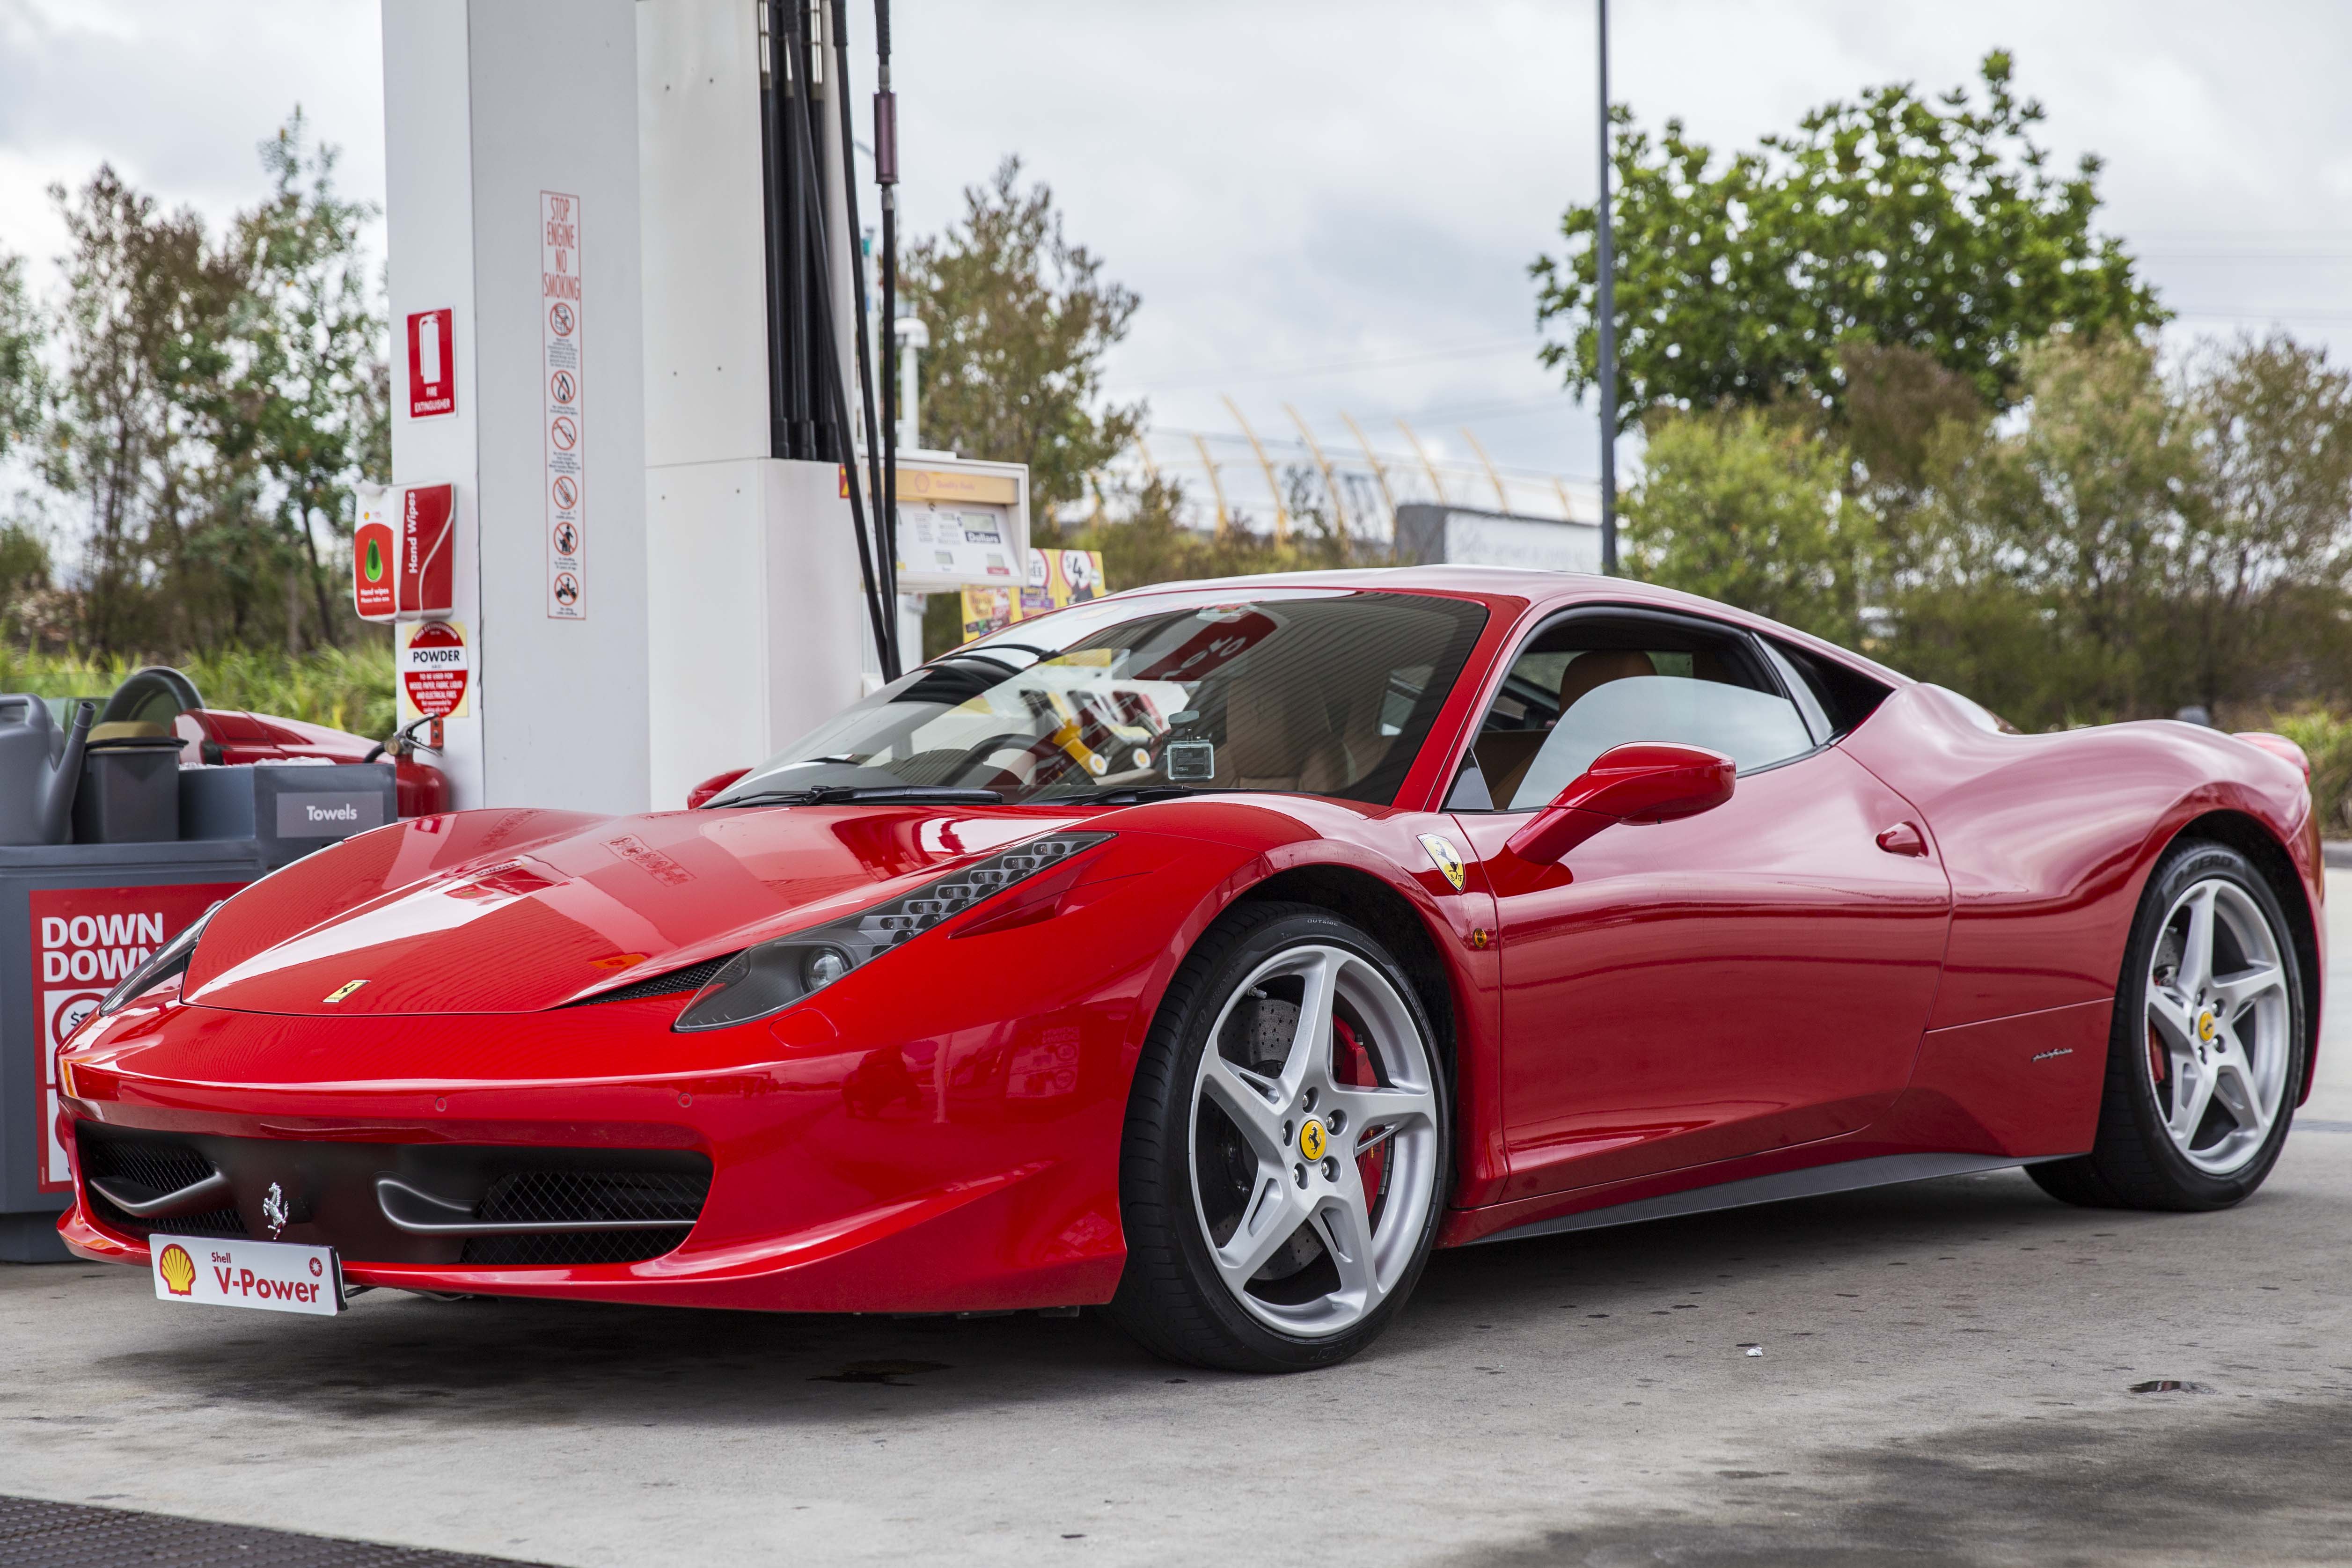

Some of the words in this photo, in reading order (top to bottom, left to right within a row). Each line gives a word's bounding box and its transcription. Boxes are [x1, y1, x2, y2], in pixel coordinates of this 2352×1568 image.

[550, 196, 570, 221] STOP
[547, 221, 575, 249] ENGINE
[556, 249, 567, 273] NO
[544, 272, 580, 300] SMOKING
[426, 386, 438, 397] FIRE
[414, 398, 451, 413] EXTINGUISHER
[406, 491, 419, 534] Wipes
[968, 532, 999, 542] Dollars
[407, 536, 418, 574] Hand
[360, 587, 374, 596] Hand
[374, 587, 389, 596] wipes
[413, 650, 460, 663] POWDER
[307, 803, 357, 821] Towels
[42, 912, 163, 948] DOWN
[211, 1252, 231, 1263] Shell
[213, 1266, 319, 1303] V-Power
